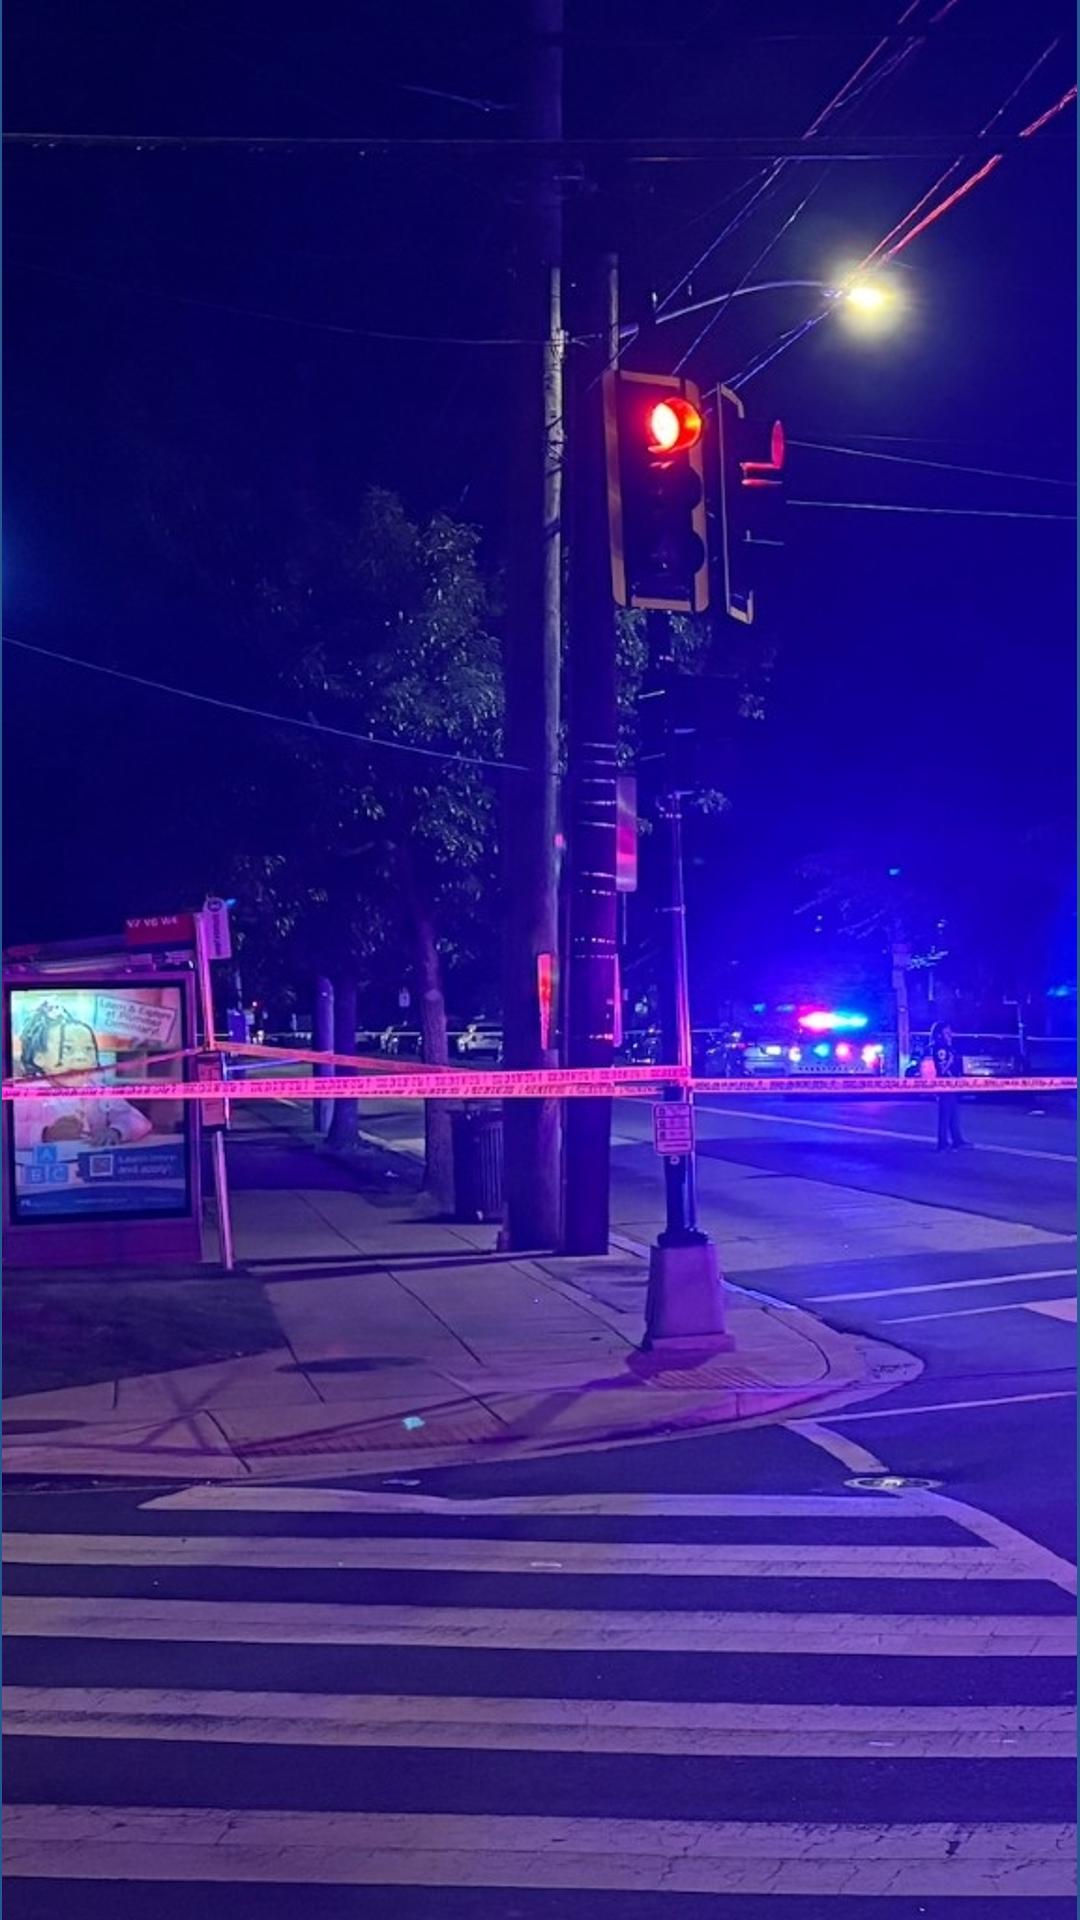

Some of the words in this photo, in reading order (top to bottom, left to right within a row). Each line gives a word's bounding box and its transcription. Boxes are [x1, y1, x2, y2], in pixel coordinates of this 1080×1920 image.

[41, 1147, 53, 1160] A
[31, 1168, 41, 1181] B
[52, 1166, 64, 1181] C
